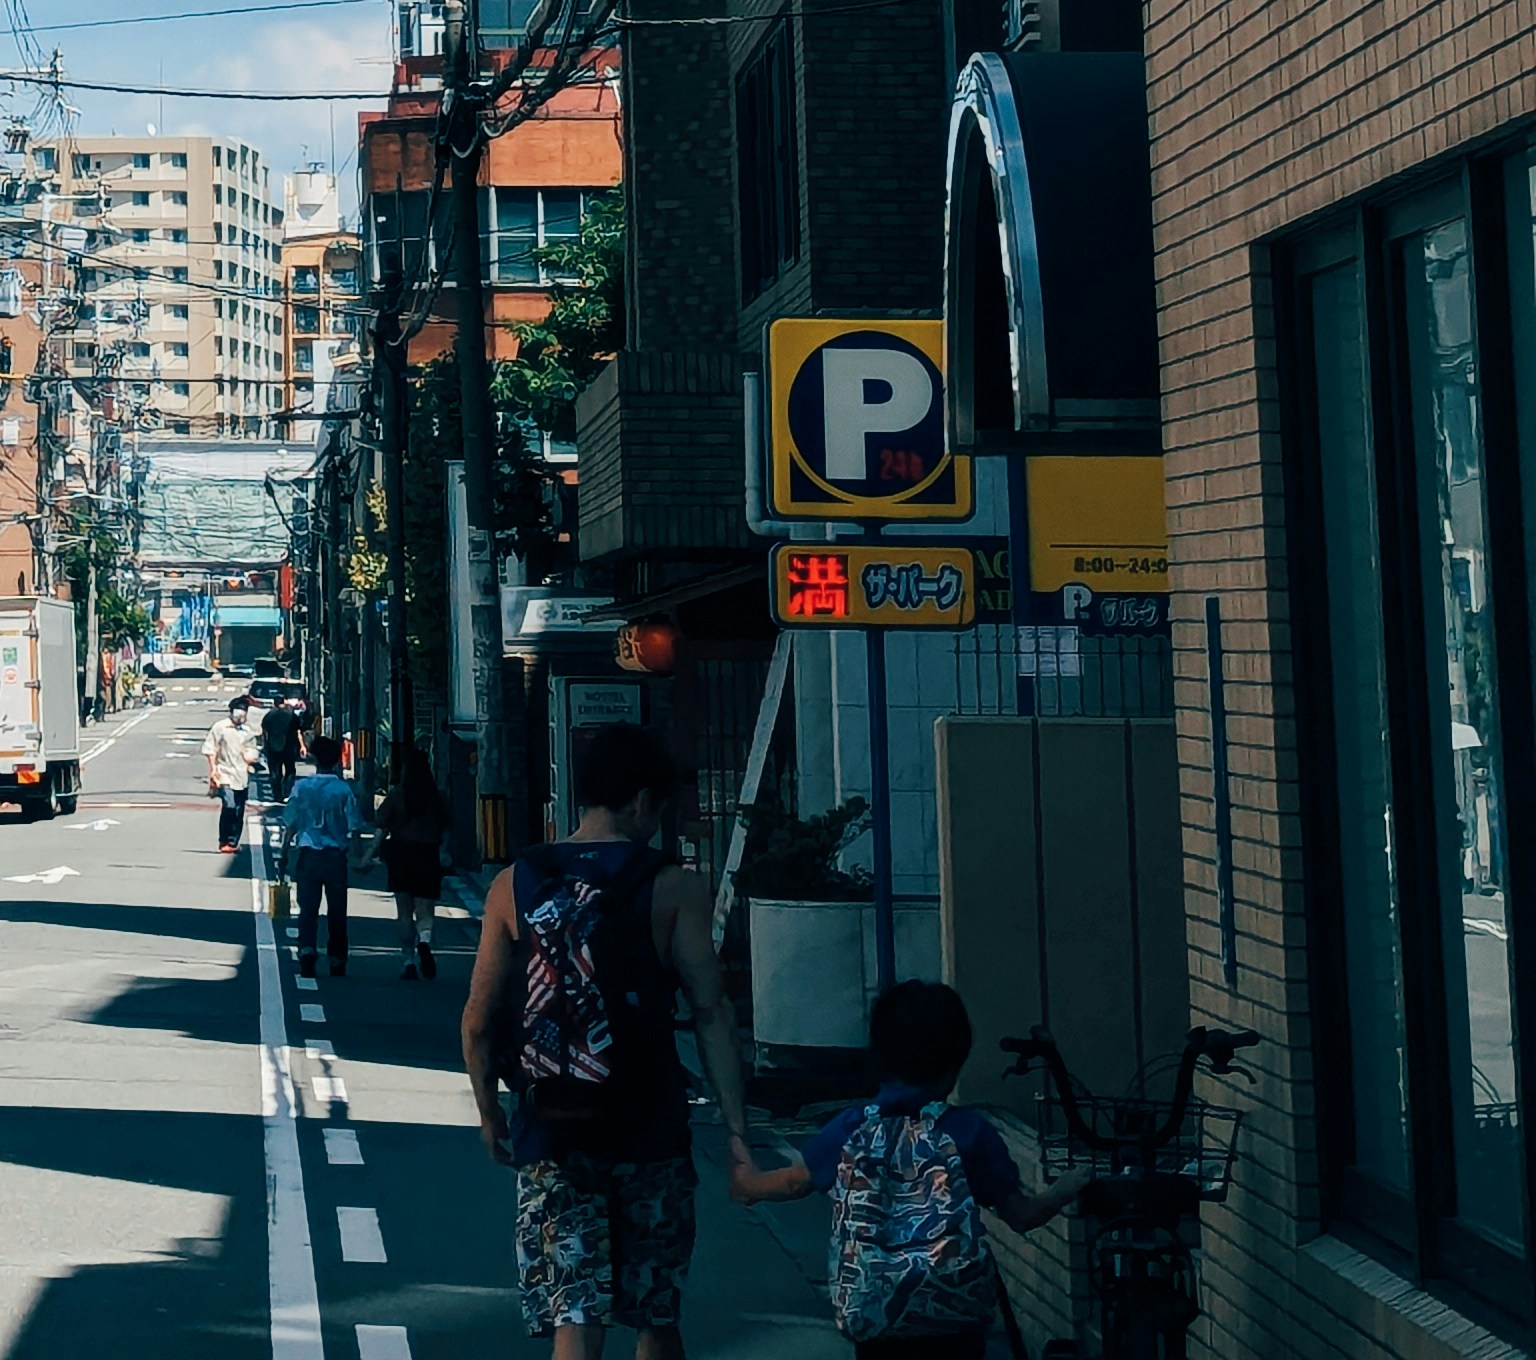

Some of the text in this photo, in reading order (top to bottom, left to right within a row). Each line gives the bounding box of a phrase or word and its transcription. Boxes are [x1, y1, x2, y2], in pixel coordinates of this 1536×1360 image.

[823, 348, 932, 479] P
[787, 554, 848, 616] 満
[865, 564, 961, 610] ザ・パーク
